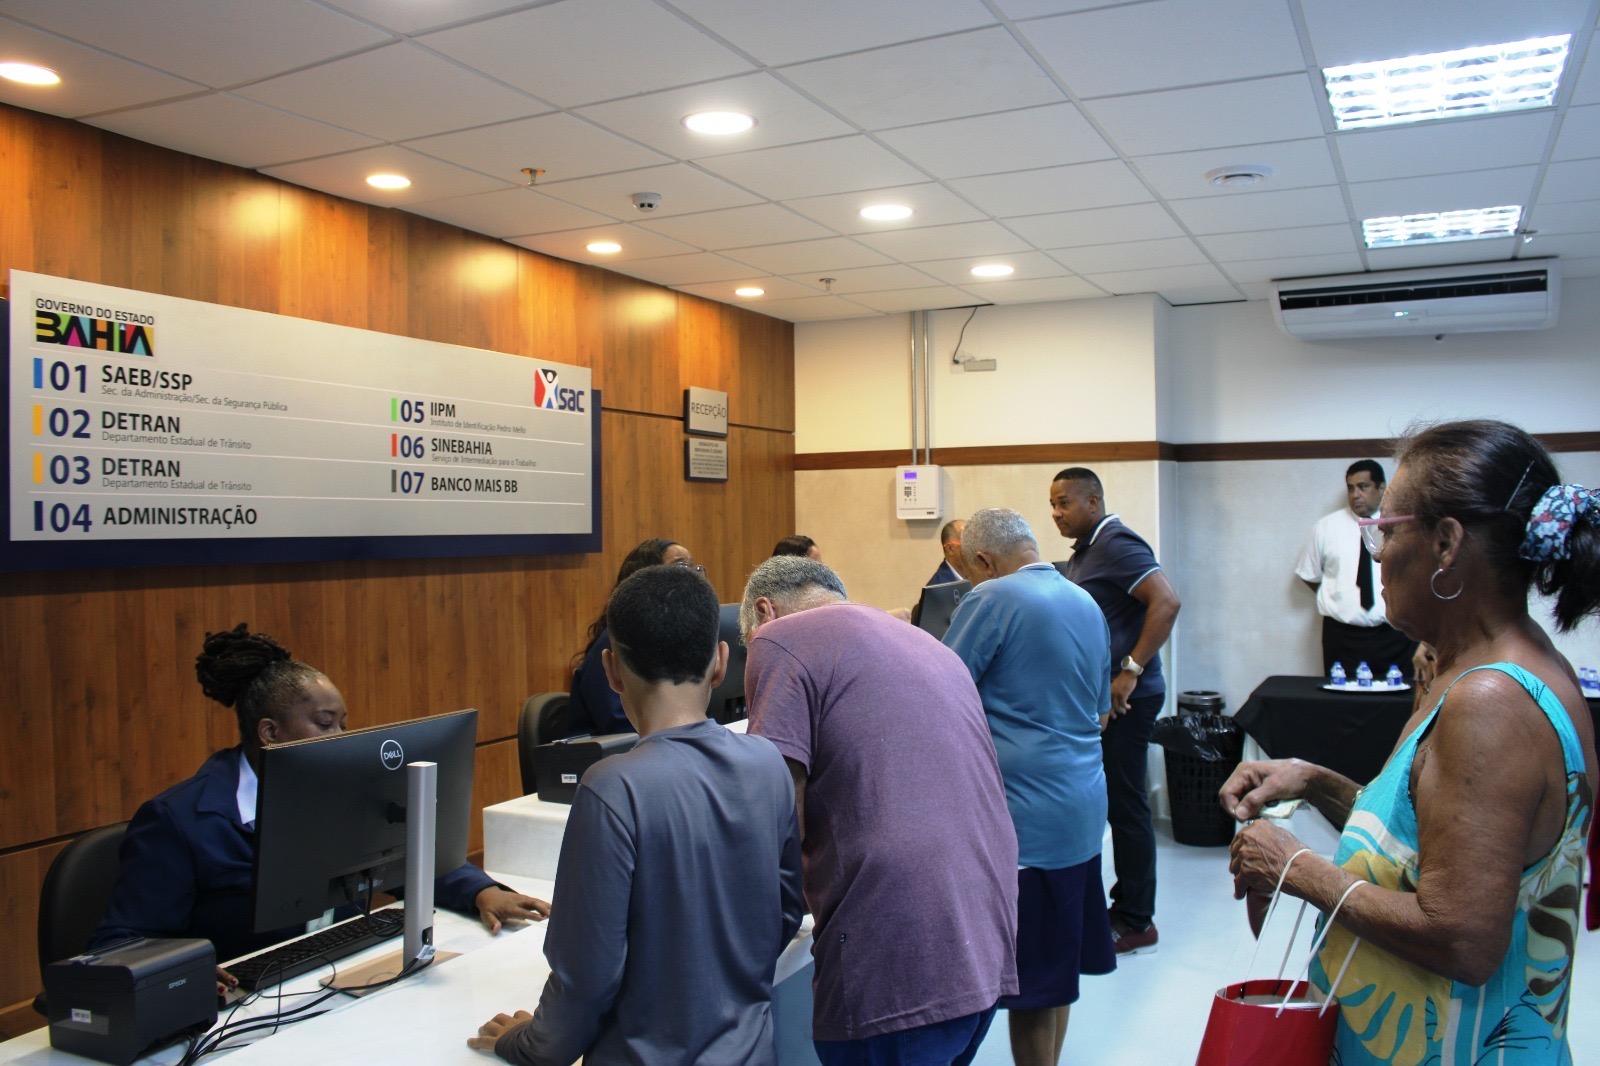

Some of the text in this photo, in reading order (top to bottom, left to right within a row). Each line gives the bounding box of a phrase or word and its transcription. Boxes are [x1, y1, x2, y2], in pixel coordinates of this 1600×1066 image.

[36, 298, 154, 326] GOVERNO DO ESTADO
[36, 310, 154, 357] BAHIA
[50, 361, 87, 393] 01
[102, 365, 193, 391] SAEB/SSP
[102, 385, 117, 396] Sec.
[121, 388, 132, 397] da
[212, 397, 222, 406] da
[223, 397, 261, 411] Segurança
[263, 400, 288, 412] Pública
[430, 402, 456, 418] IIPM
[400, 400, 425, 423] 05
[691, 402, 726, 419] RECEPÇÃO
[49, 408, 91, 439] 02
[102, 411, 181, 434] DETRAN
[430, 418, 453, 428] Instituto
[455, 420, 462, 428] de
[463, 421, 495, 432] Identificação
[497, 425, 511, 433] Pedro
[102, 431, 252, 450] Departamento Estadual de Trânsito
[400, 435, 425, 459] 06
[431, 438, 493, 456] SINEBAHIA
[50, 455, 91, 485] 03
[102, 457, 181, 478] DETRAN
[431, 453, 452, 464] Serviço
[453, 455, 459, 463] de
[461, 455, 498, 466] Intermediação
[499, 458, 509, 467] para
[515, 458, 537, 467] Trabalho
[102, 477, 252, 491] Departamento Estadual de Trânsito
[400, 471, 425, 494] 07
[431, 477, 518, 493] BANCO MAIS BB
[50, 502, 92, 533] 04
[103, 505, 258, 529] ADMINISTRAÇÃO
[383, 749, 402, 761] DELL
